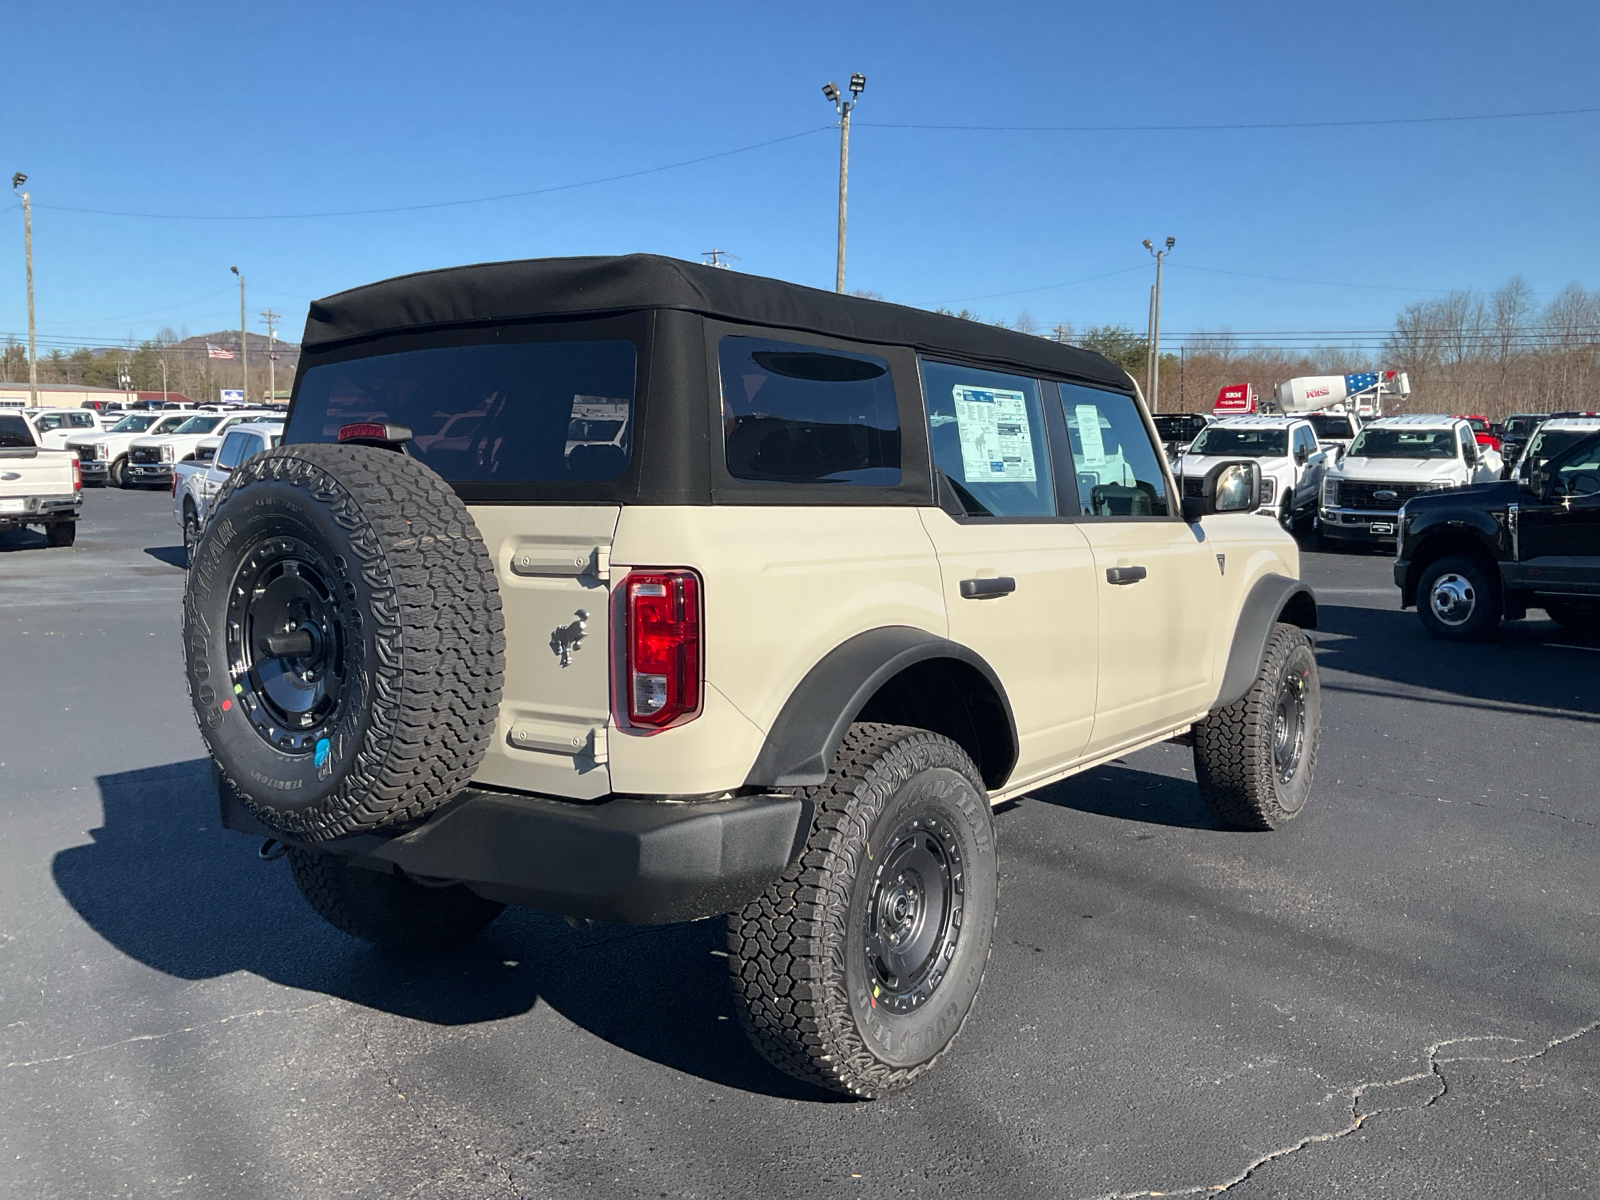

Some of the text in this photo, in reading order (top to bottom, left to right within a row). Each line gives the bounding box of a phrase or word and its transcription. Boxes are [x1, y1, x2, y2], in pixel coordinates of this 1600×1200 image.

[189, 516, 237, 729] GOODYEAR
[249, 768, 303, 790] TERRITORY
[896, 778, 989, 856] GOODYEAR
[858, 987, 958, 1061] GOODYEAR
